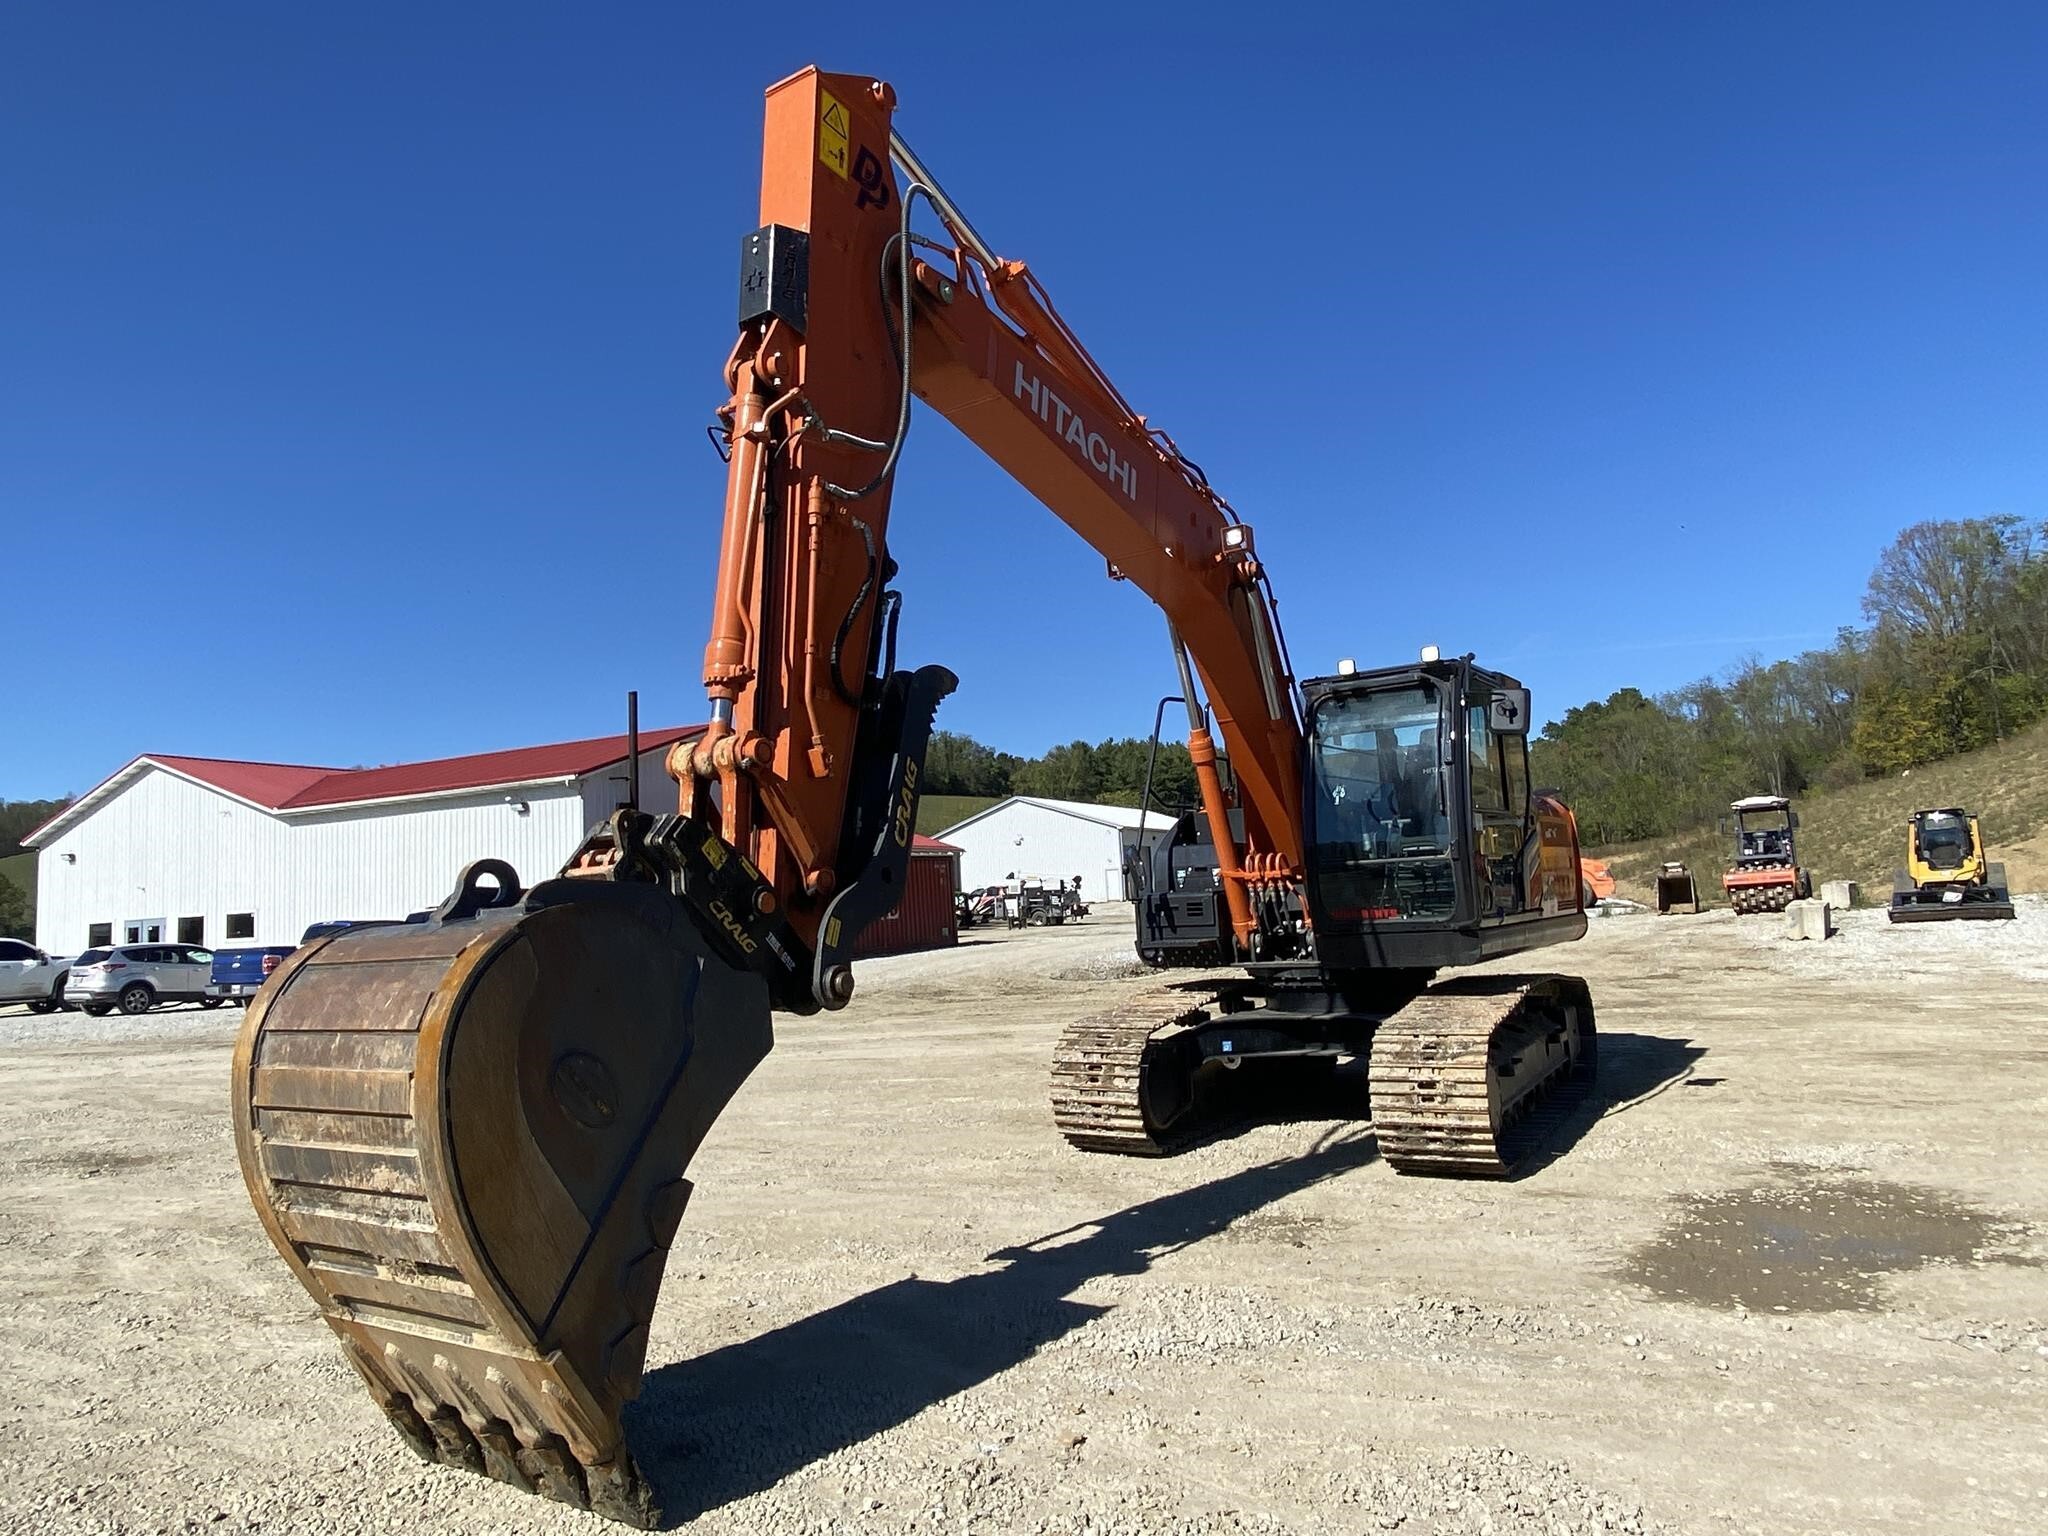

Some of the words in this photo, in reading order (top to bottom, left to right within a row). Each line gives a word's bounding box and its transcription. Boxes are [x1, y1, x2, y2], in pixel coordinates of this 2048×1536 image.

[1014, 360, 1137, 501] HITACHI
[894, 756, 918, 848] CRAIG
[709, 900, 758, 953] CRAIG
